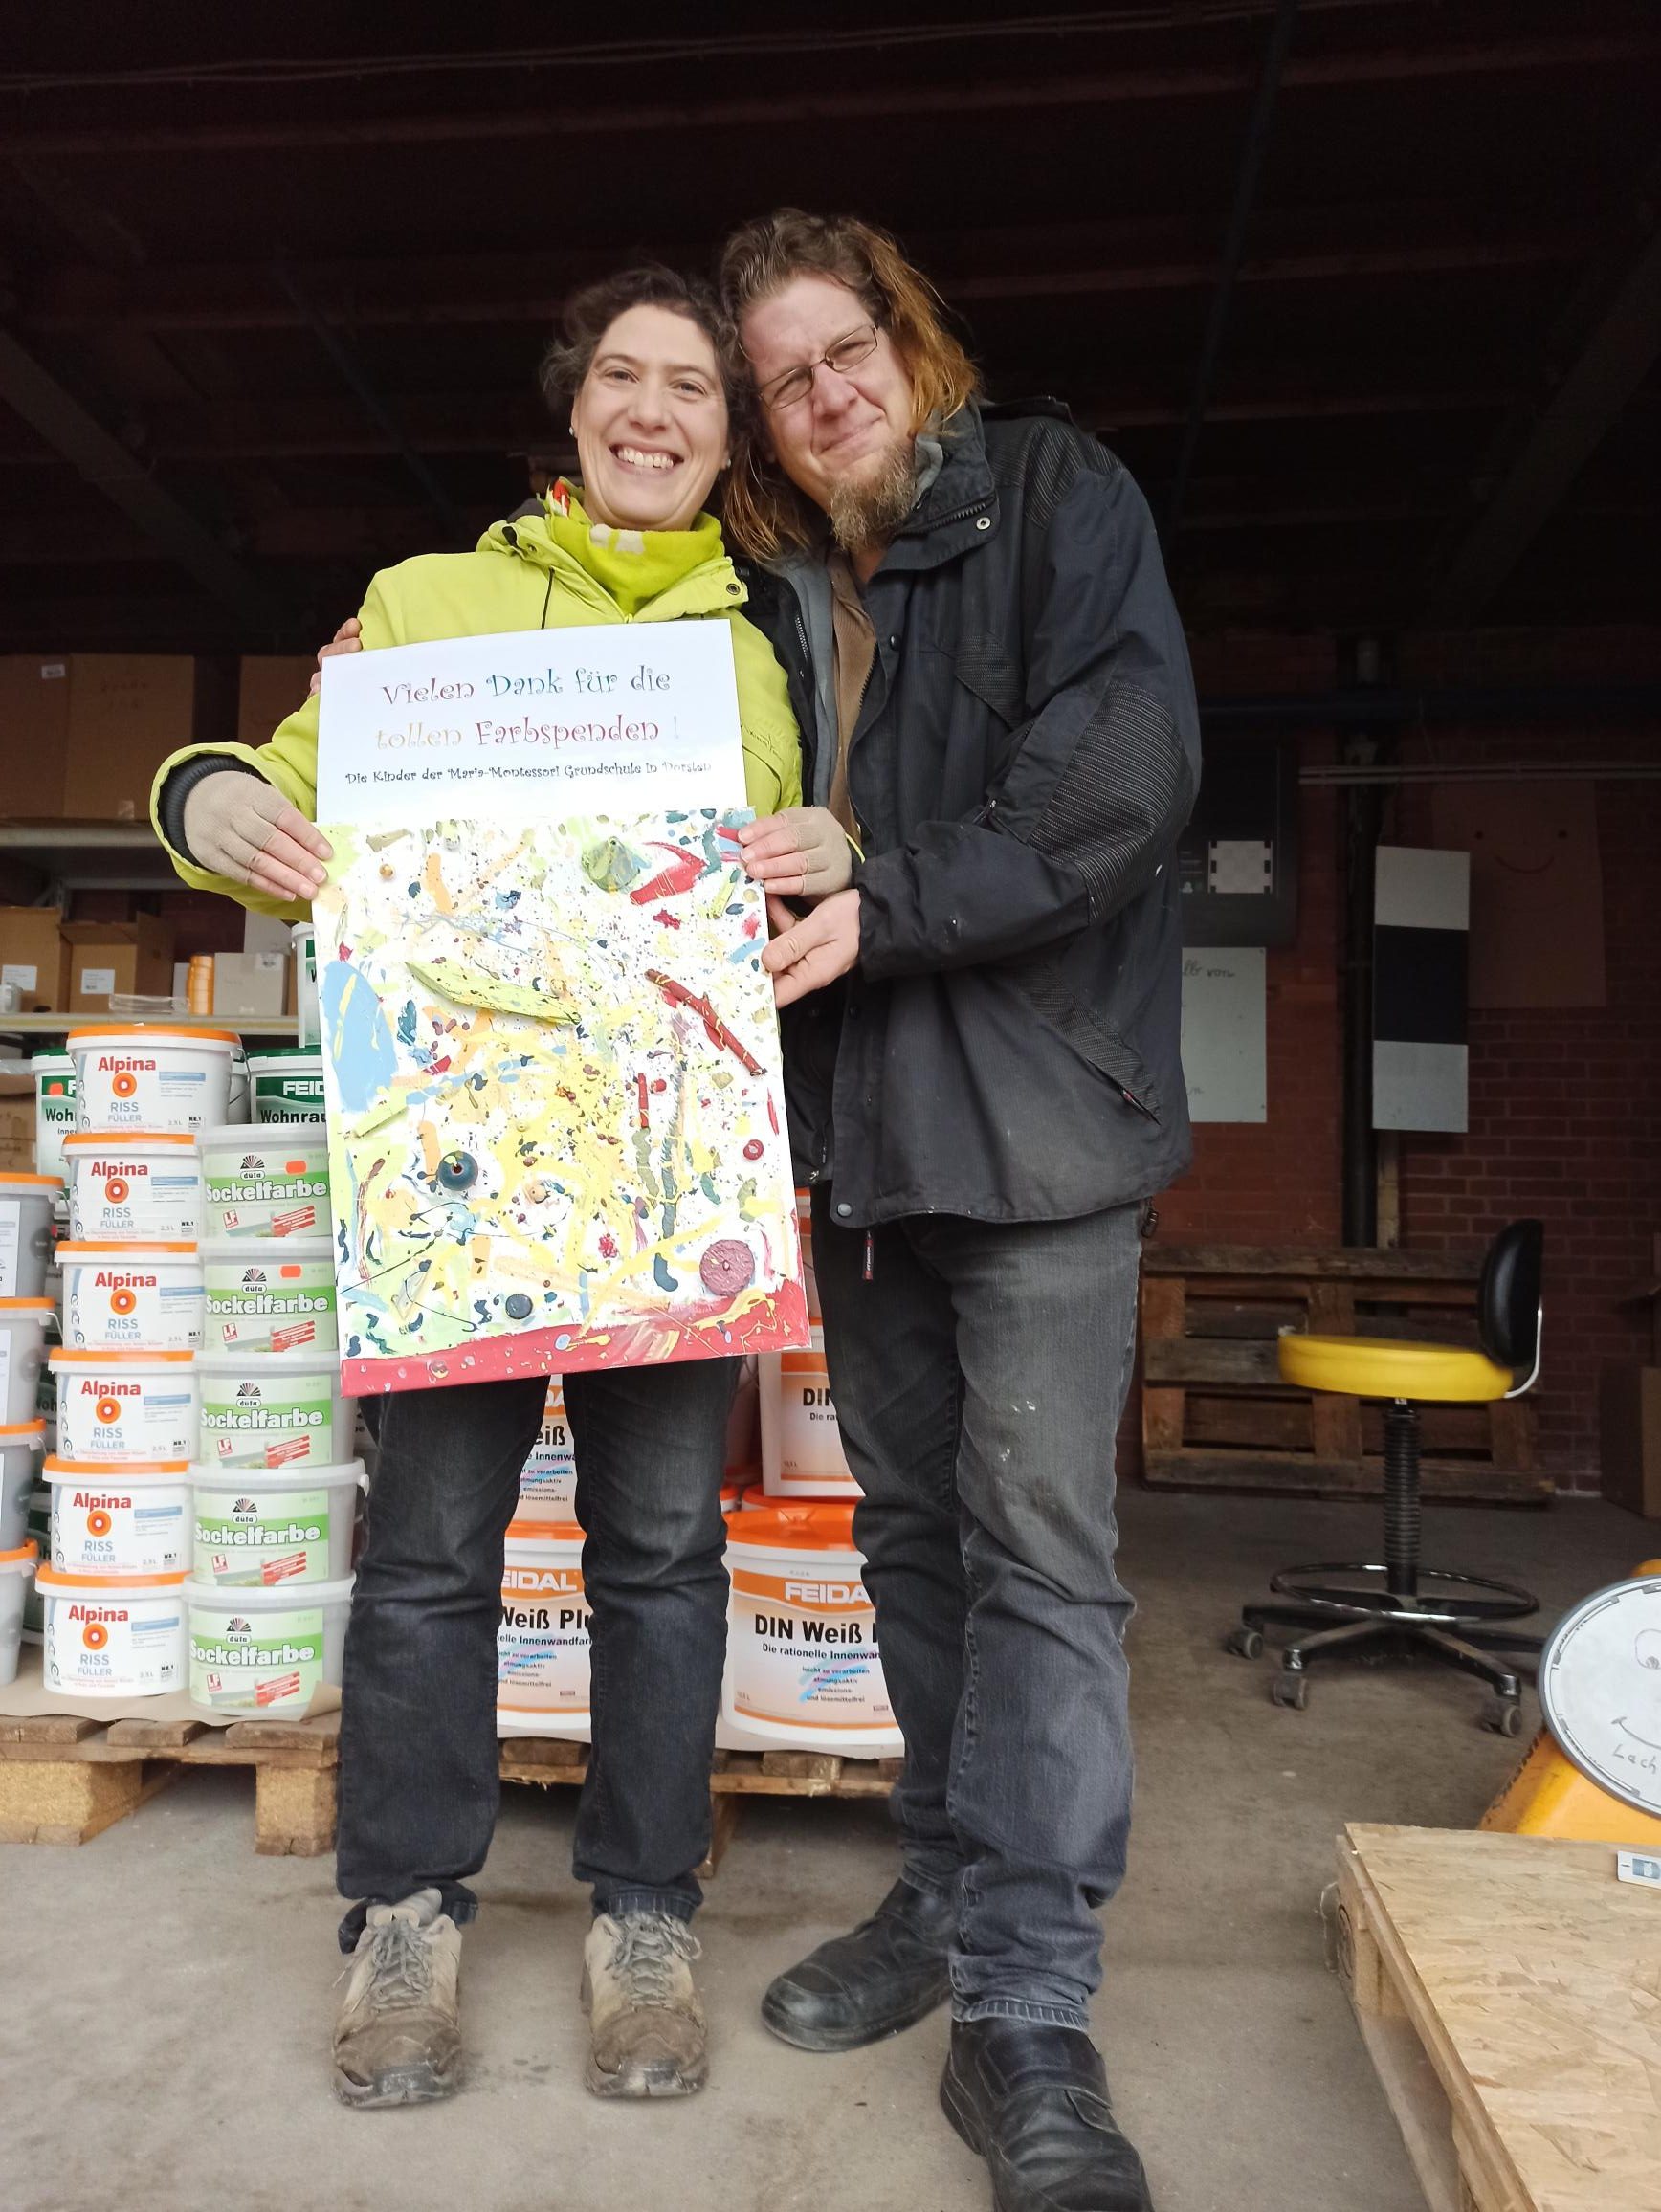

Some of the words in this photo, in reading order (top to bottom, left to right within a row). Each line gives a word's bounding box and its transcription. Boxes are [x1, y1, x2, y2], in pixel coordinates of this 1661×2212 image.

[382, 677, 475, 705] Vielen
[485, 668, 564, 697] Dank
[575, 667, 618, 693] für
[631, 665, 670, 691] die
[376, 721, 462, 750] tollen
[474, 714, 659, 750] Farbspenden
[345, 773, 368, 784] Die
[373, 769, 418, 783] Kinder
[422, 768, 443, 780] der
[565, 763, 642, 778] Grundschule
[646, 763, 658, 774] in
[98, 1056, 156, 1073] Alpina
[46, 1108, 77, 1122] Woh
[110, 1102, 139, 1112] RISS
[108, 1113, 142, 1122] FÜLLER
[91, 1161, 148, 1179] Alpina
[207, 1179, 327, 1203] Sockelfarbe
[103, 1207, 131, 1218] RISS
[100, 1219, 134, 1228] FÜLLER
[95, 1272, 157, 1291] Alpina
[206, 1294, 328, 1315] Sockelfarbe
[108, 1319, 138, 1329] RISS
[105, 1330, 141, 1339] FÜLLER
[81, 1381, 141, 1400] Alpina
[200, 1407, 323, 1429] Sockelfarbe
[94, 1427, 122, 1438] RISS
[535, 1426, 566, 1446] eiß
[91, 1439, 124, 1449] FÜLLER
[536, 1451, 575, 1461] Innenwa
[73, 1493, 132, 1512] Alpina
[195, 1523, 321, 1545] Sockelfarbe
[84, 1540, 113, 1552] RISS
[81, 1553, 115, 1562] FÜLLER
[503, 1570, 577, 1591] EIDAL
[785, 1582, 871, 1604] FEIDA
[69, 1605, 128, 1625] Alpina
[755, 1614, 793, 1640] DIN
[802, 1621, 862, 1644] Weiß
[520, 1635, 592, 1646] Innenwandfar
[80, 1654, 109, 1665] RISS
[191, 1639, 315, 1666] Sockelfarbe
[763, 1643, 777, 1653] Die
[780, 1648, 827, 1659] rationelle
[830, 1651, 880, 1660] Innenwan
[78, 1667, 112, 1676] FÜLLER
